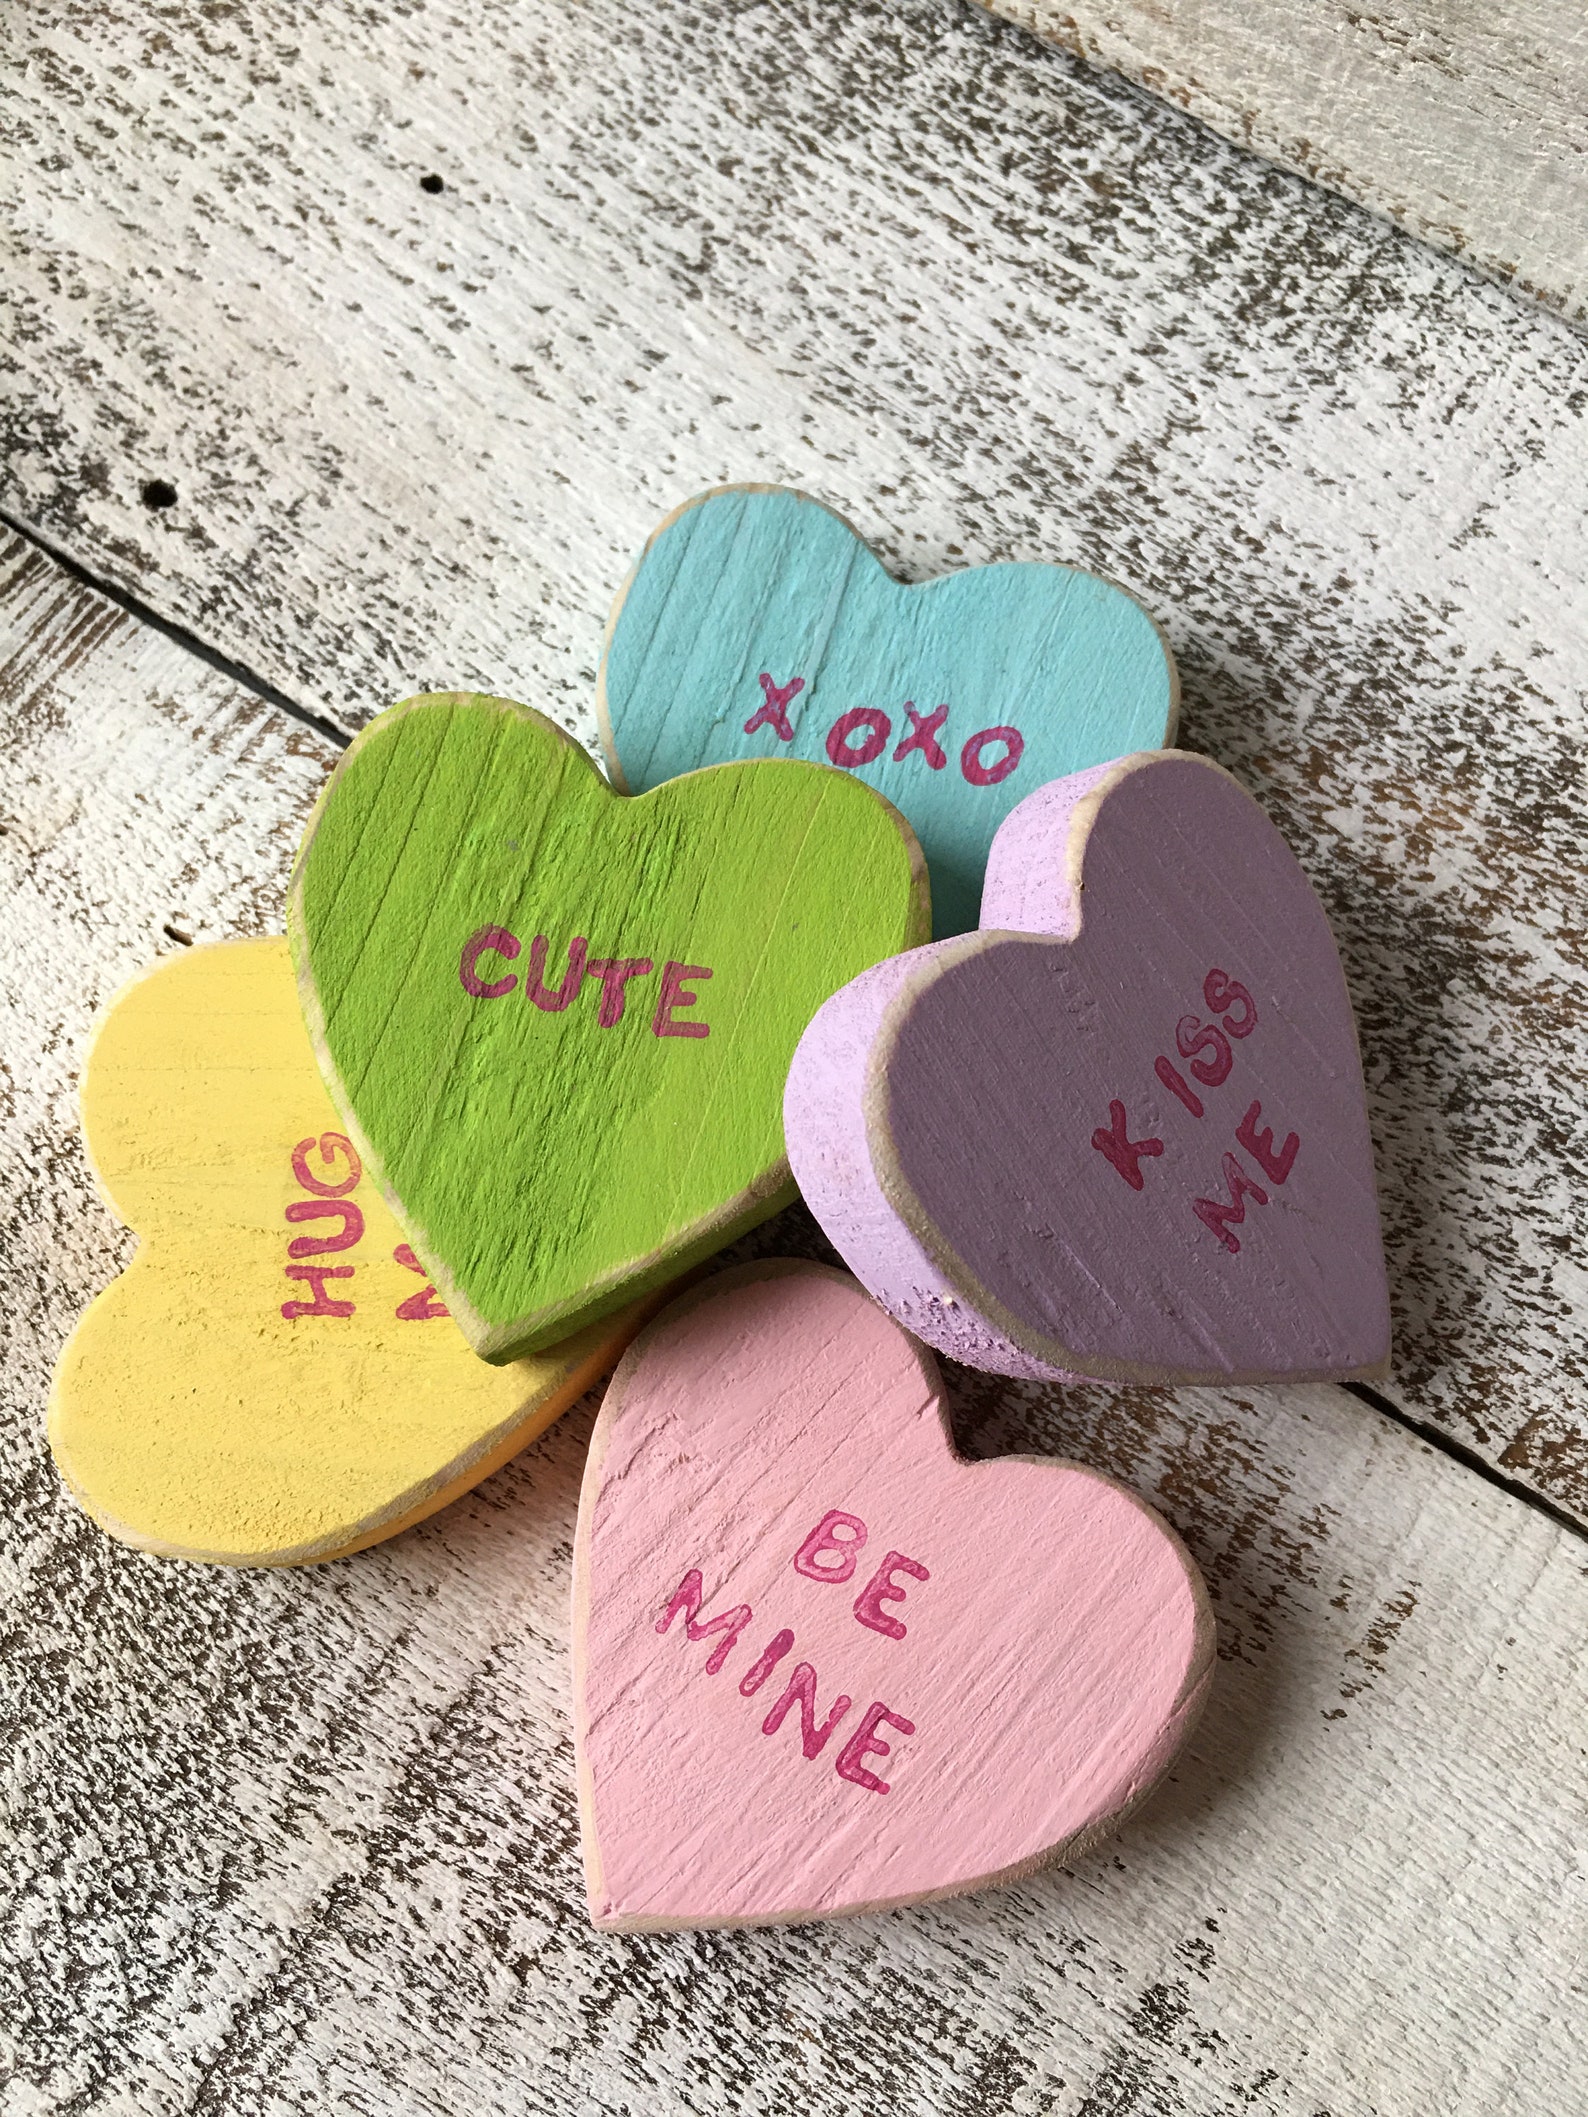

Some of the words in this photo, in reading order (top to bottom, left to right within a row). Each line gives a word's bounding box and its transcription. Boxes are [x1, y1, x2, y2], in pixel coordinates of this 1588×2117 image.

[744, 673, 1024, 786] XOXO
[459, 923, 713, 1038] CUTE
[1091, 968, 1258, 1191] KISS
[281, 1131, 365, 1319] HUG
[1192, 1100, 1300, 1254] ME
[793, 1509, 930, 1641] BE
[655, 1568, 916, 1796] MINE
